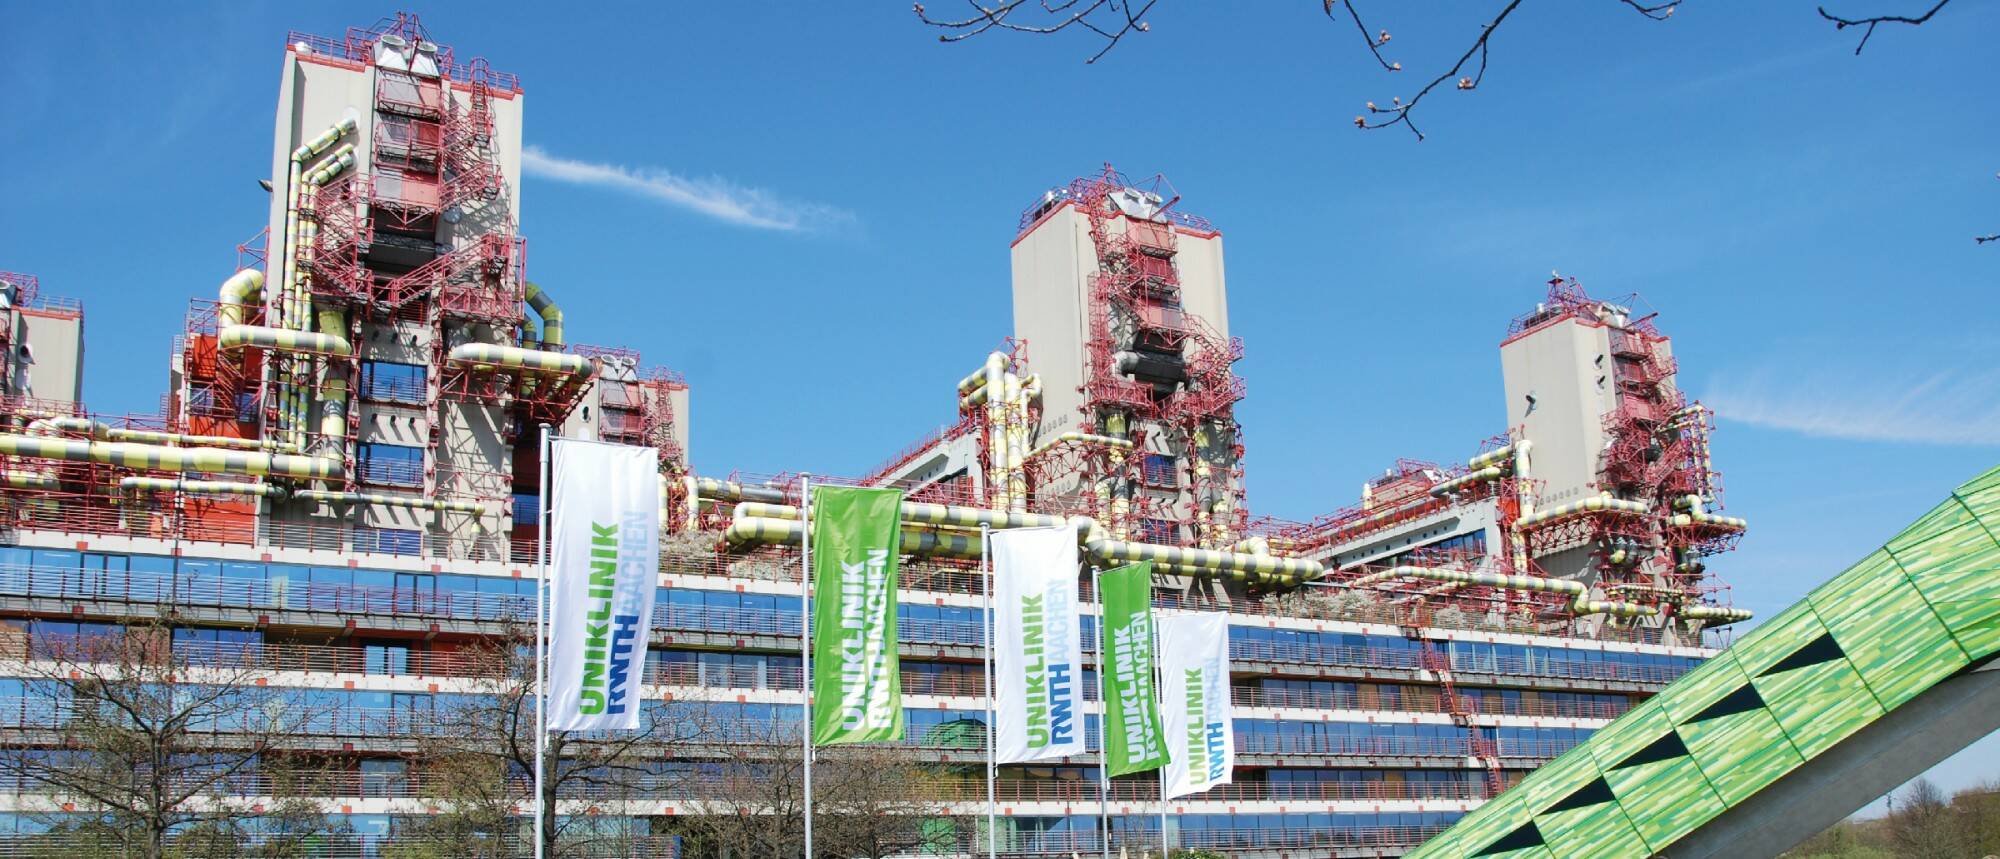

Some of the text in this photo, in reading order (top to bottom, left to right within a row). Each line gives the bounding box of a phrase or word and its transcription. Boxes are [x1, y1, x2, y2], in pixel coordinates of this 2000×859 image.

[579, 520, 619, 716] UNIKLINIK
[841, 560, 866, 731] UNIKLINIK
[1021, 592, 1049, 749] UNIKLINIK
[1114, 624, 1147, 765] UNIKLINIK
[1184, 667, 1207, 786] UNIKLINIK
